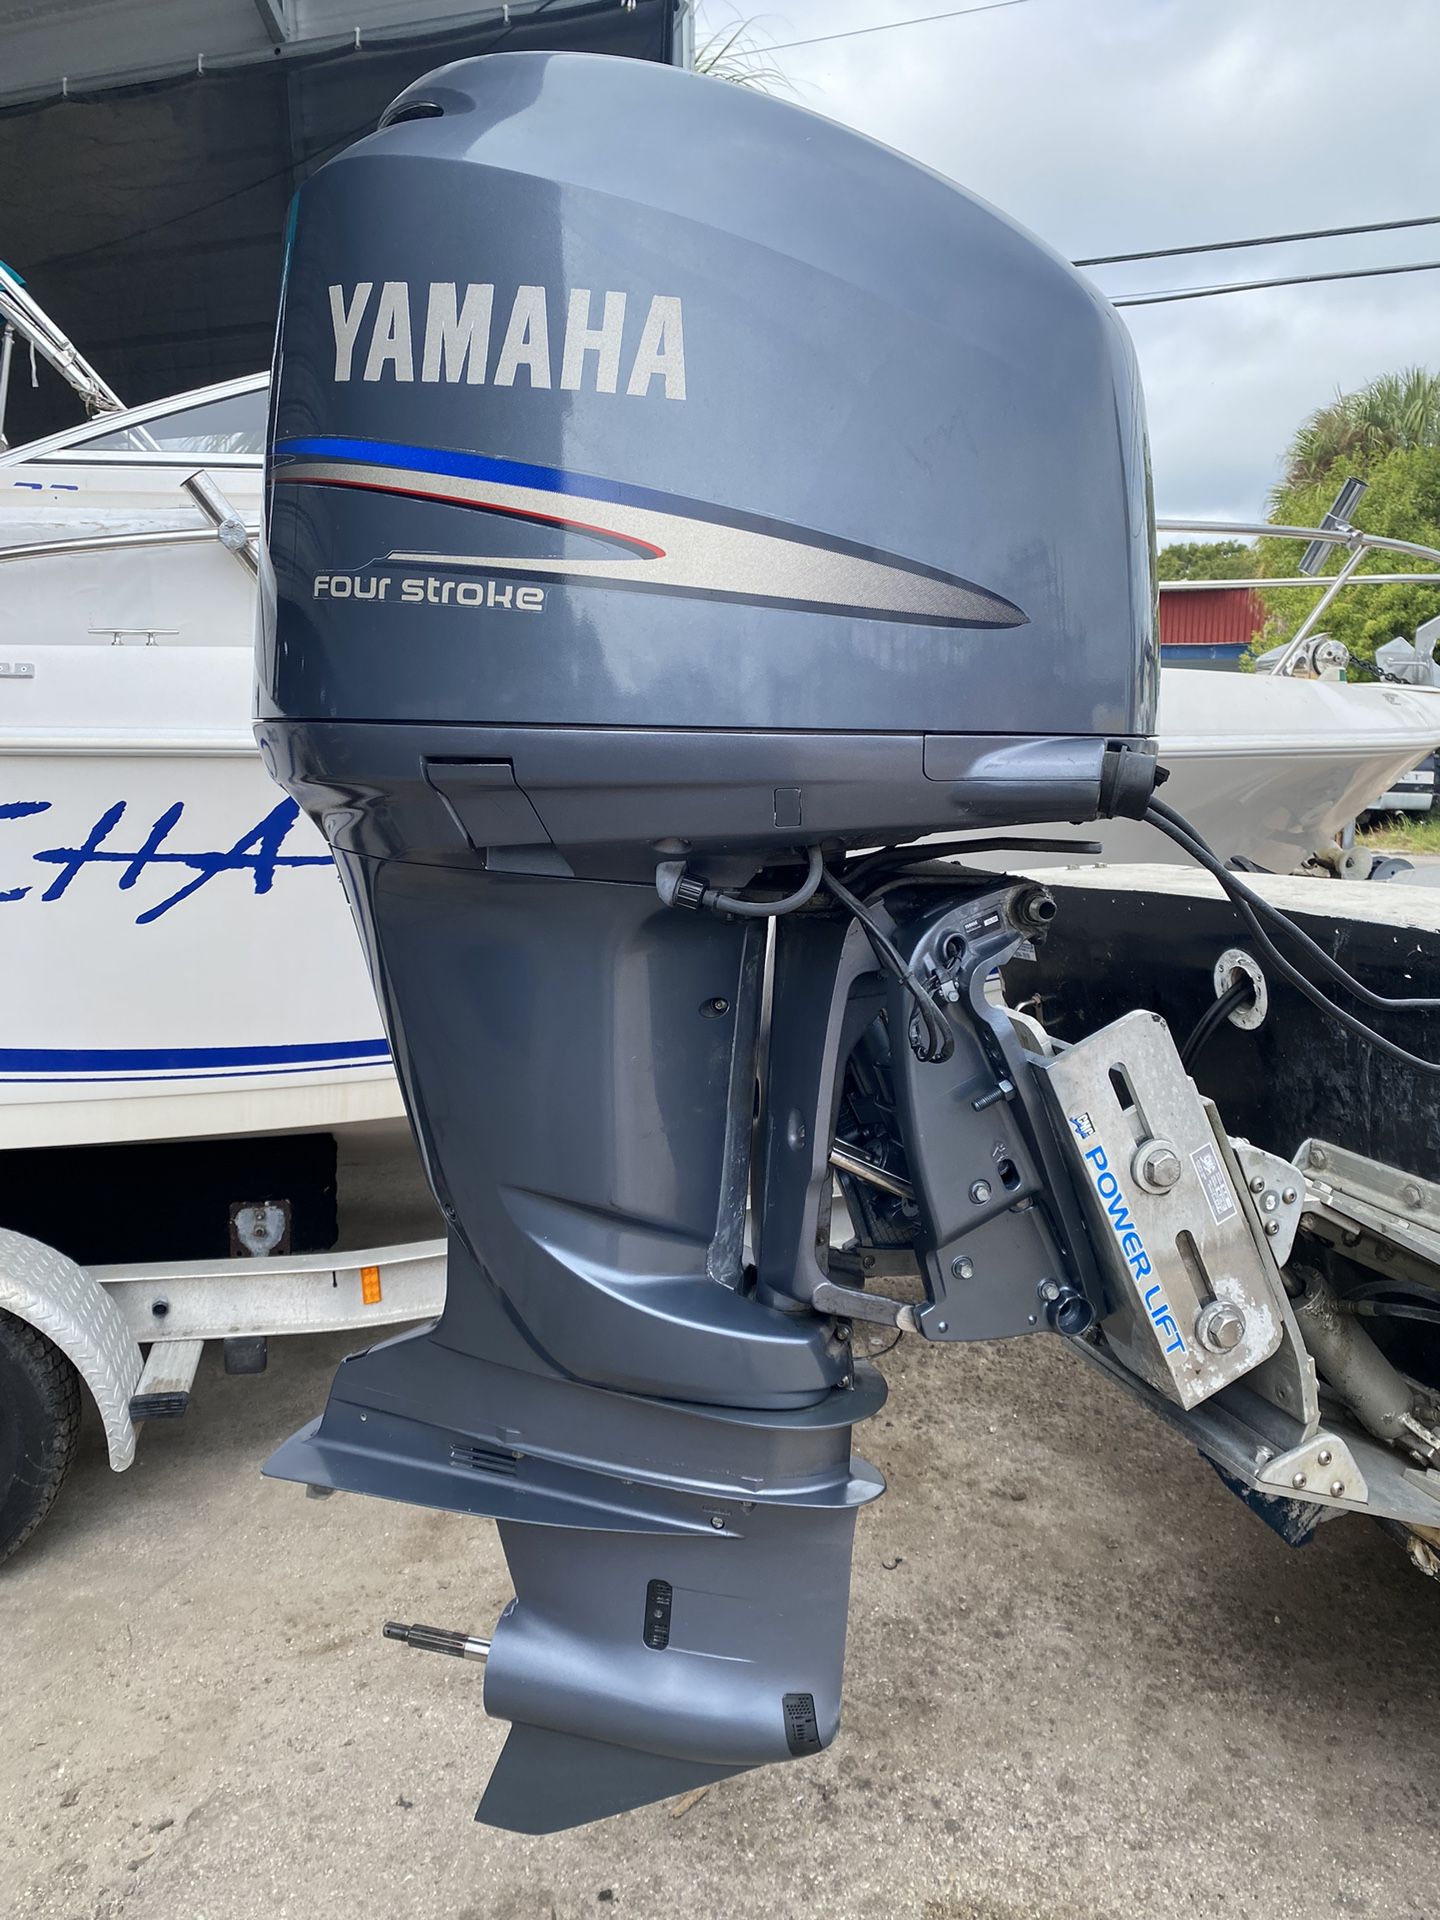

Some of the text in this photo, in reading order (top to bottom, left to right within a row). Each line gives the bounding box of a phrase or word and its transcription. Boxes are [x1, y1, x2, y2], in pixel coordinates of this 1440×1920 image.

[329, 281, 687, 401] YAMAHA
[1084, 1144, 1185, 1354] POWER LIFT
